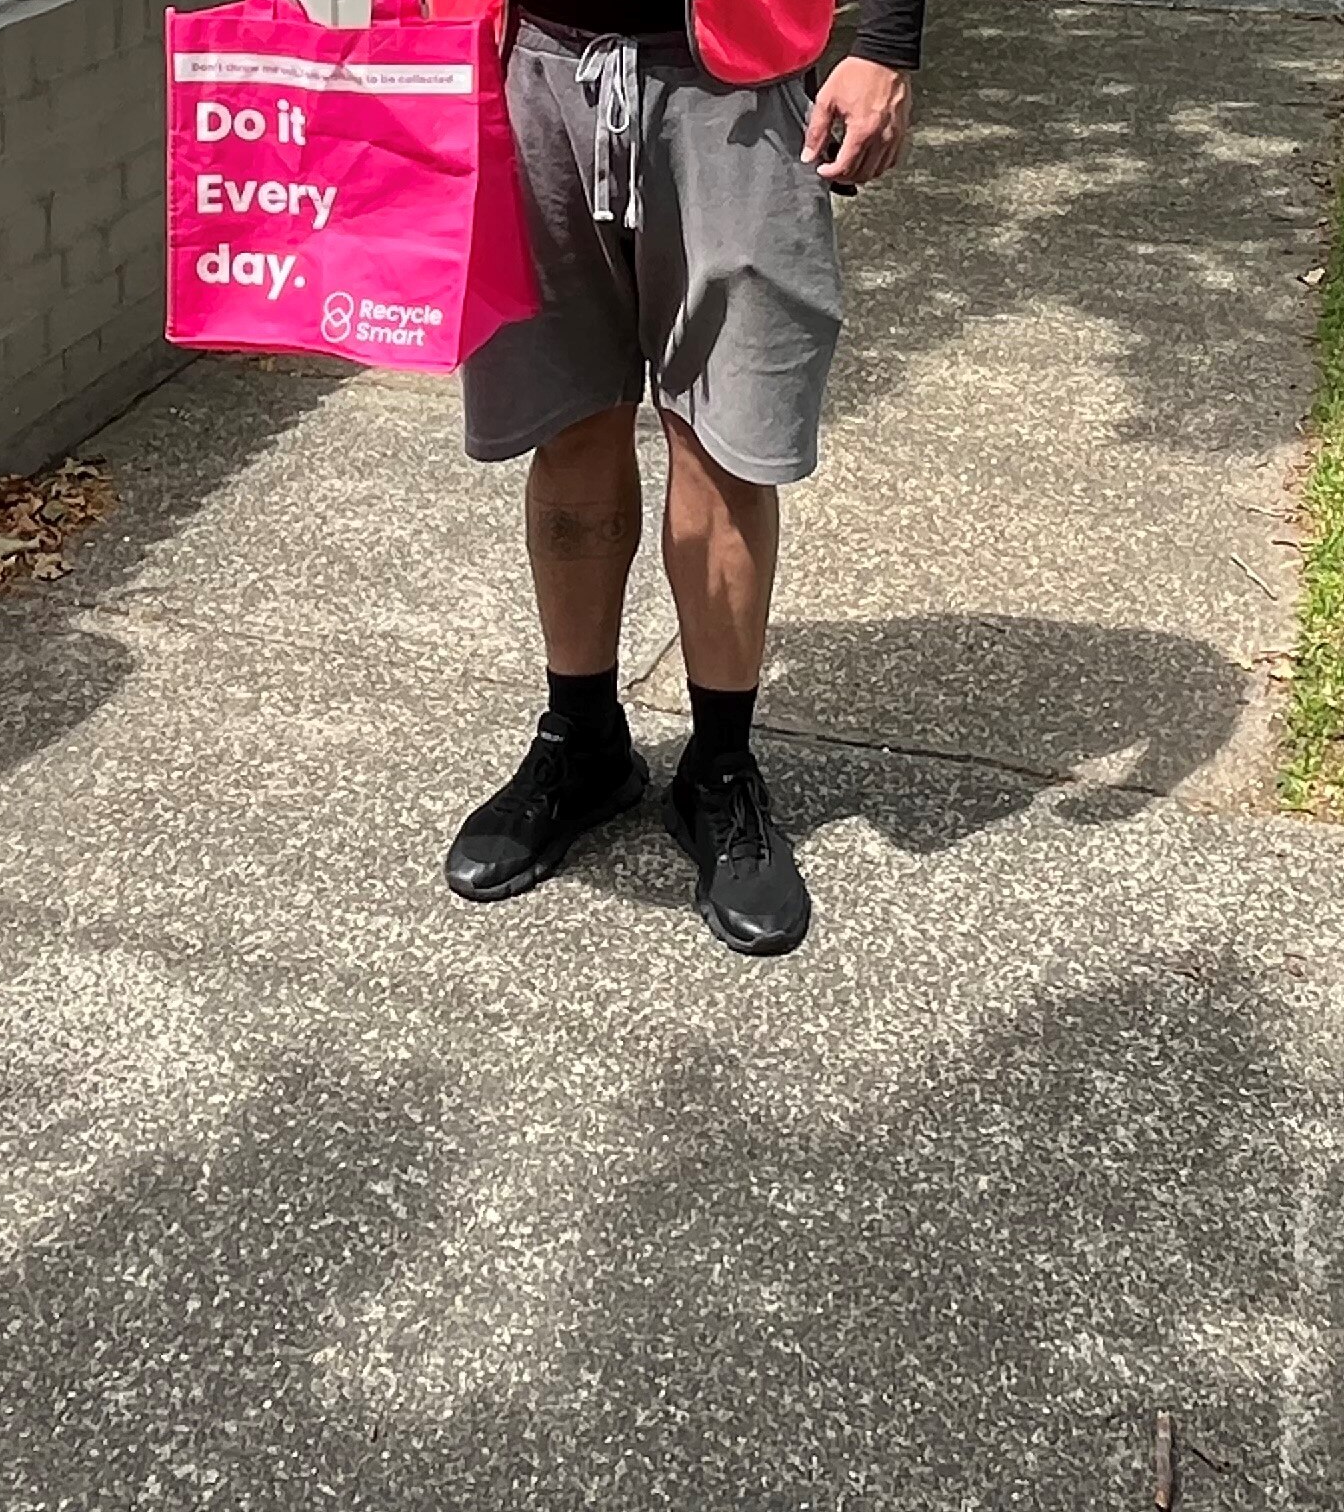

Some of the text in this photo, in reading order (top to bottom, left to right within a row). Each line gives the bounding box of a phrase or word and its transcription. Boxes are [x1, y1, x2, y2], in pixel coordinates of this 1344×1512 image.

[365, 74, 378, 84] to
[381, 73, 396, 84] be
[196, 98, 307, 146] Do it
[196, 173, 338, 230] Every
[196, 242, 307, 300] day.
[359, 298, 444, 329] Recycle
[355, 322, 426, 346] Smart
